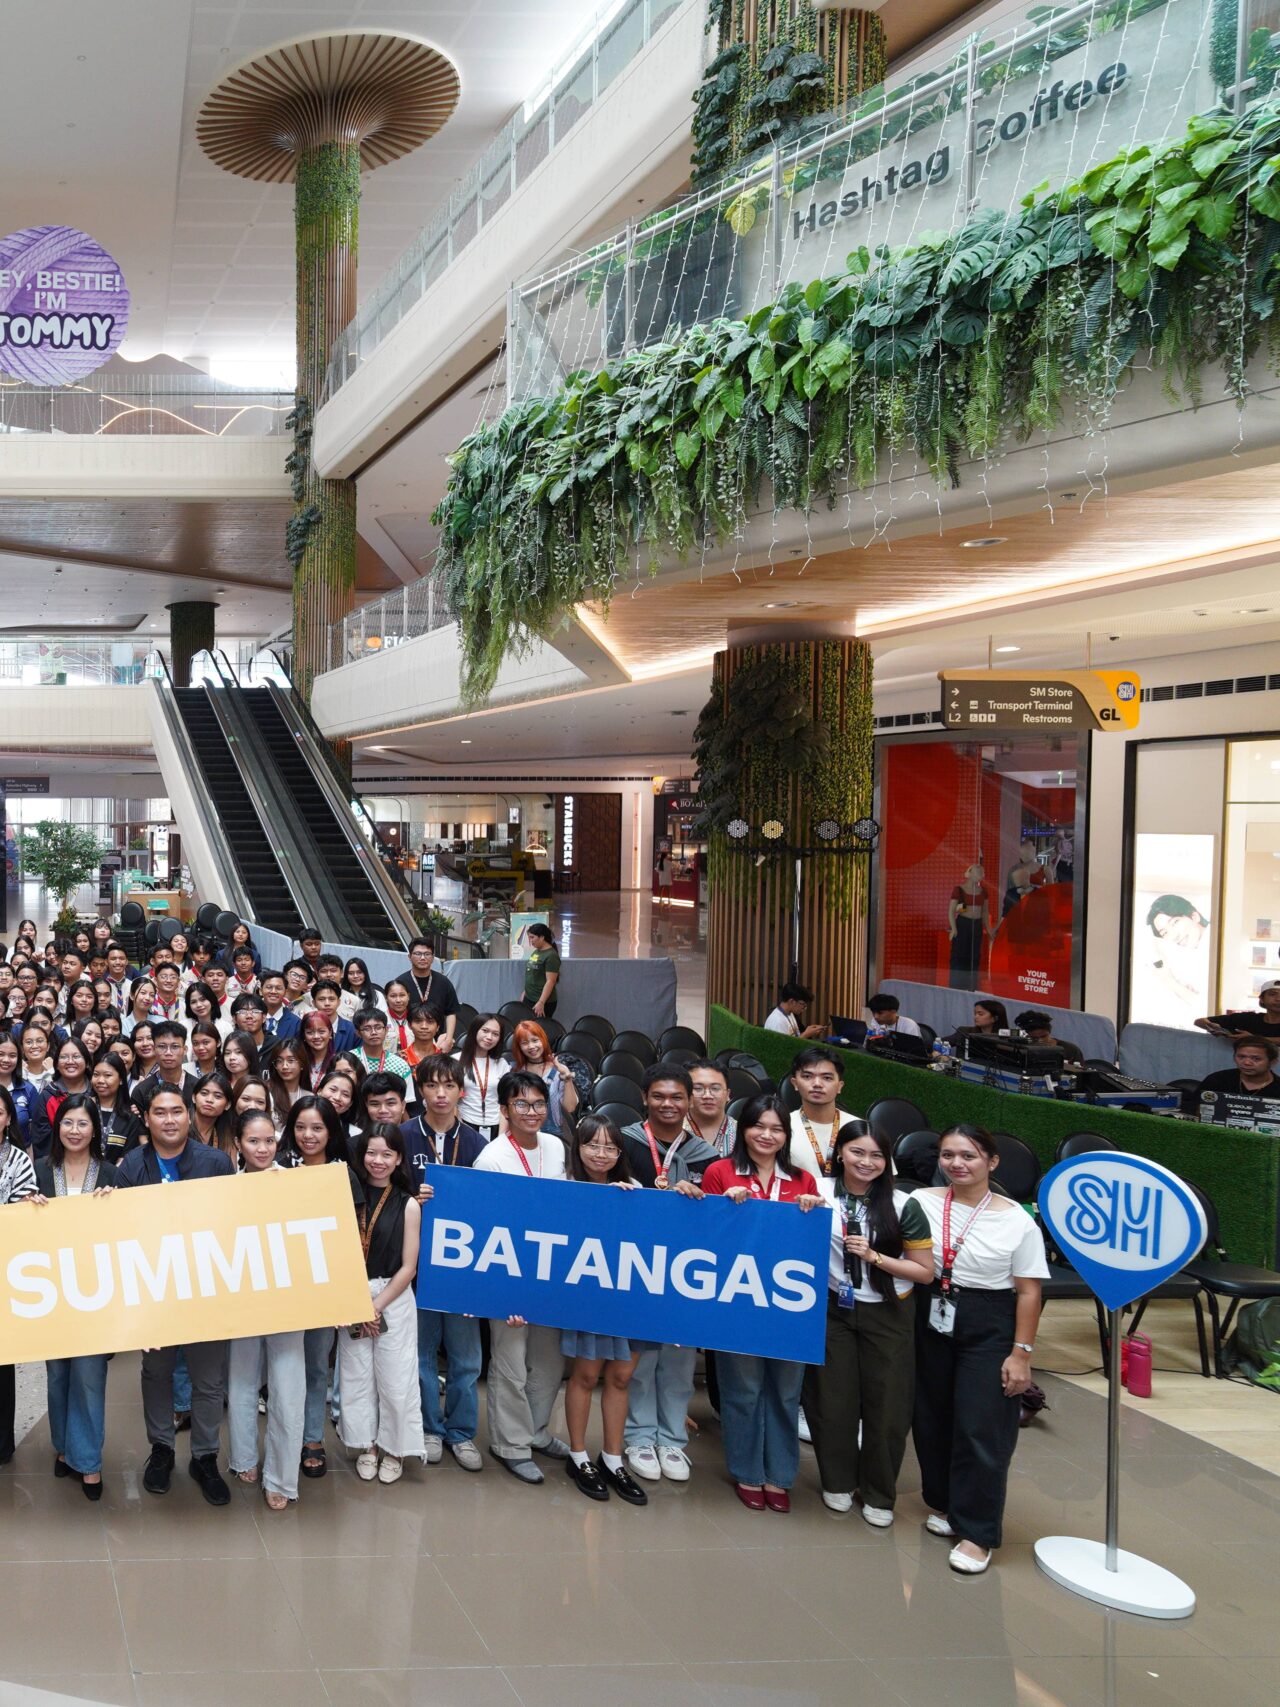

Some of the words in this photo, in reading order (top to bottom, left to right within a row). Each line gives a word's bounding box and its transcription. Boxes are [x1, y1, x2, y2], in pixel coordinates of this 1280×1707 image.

[792, 143, 951, 240] Hashtag
[974, 61, 1130, 156] Coffee
[36, 271, 120, 292] BESTIE!
[34, 291, 67, 310] I'M
[1030, 688, 1046, 697] SM
[1048, 688, 1073, 697] Store
[988, 701, 1032, 712] Transport
[1034, 701, 1073, 710] Terminal
[948, 714, 961, 723] L2
[1023, 714, 1072, 723] Restrooms
[1099, 709, 1120, 721] GL
[564, 796, 573, 866] STARBUCKS
[1027, 969, 1048, 979] YOUR
[1018, 976, 1040, 985] EVERY
[1041, 980, 1056, 988] DAY
[1024, 984, 1048, 994] STORE
[1065, 1173, 1163, 1260] SM
[5, 1216, 338, 1319] SUMMIT
[431, 1218, 817, 1313] BATANGAS
